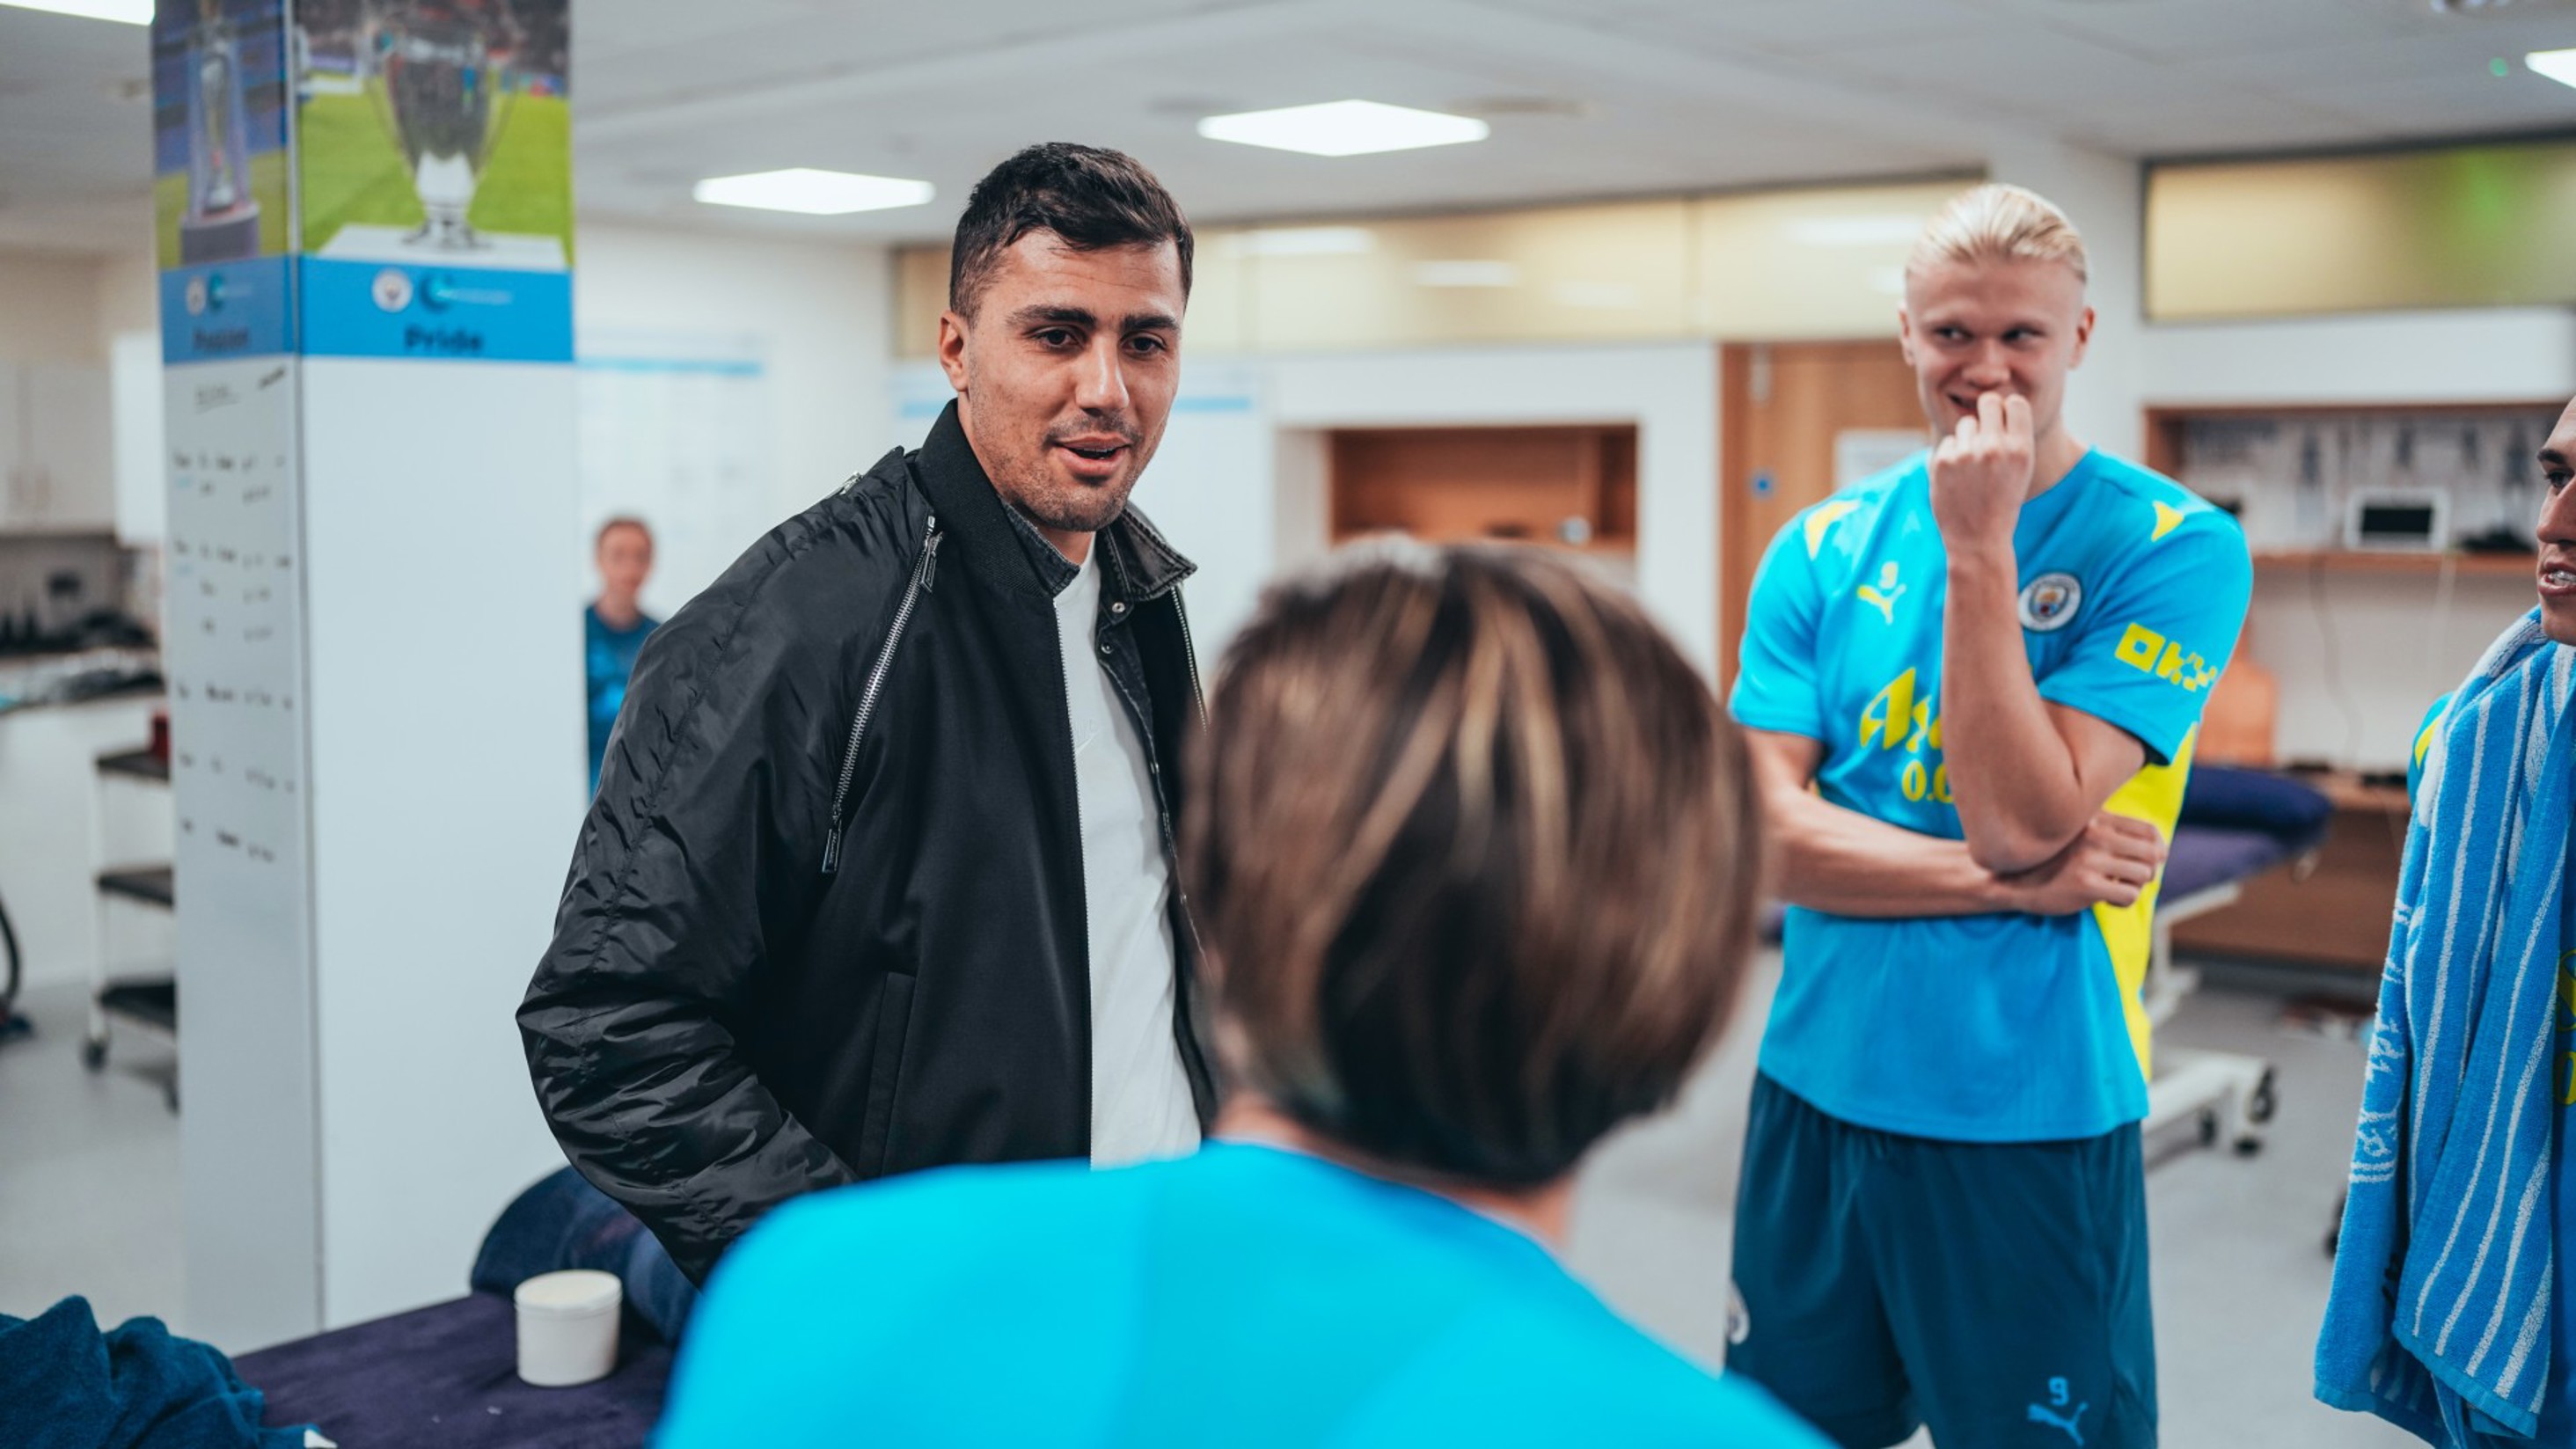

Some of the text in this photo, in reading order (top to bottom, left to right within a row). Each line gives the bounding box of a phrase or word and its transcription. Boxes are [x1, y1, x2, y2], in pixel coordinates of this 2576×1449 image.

[404, 323, 484, 354] Pride
[2115, 622, 2218, 692] OKX
[2049, 1377, 2069, 1406] 9
